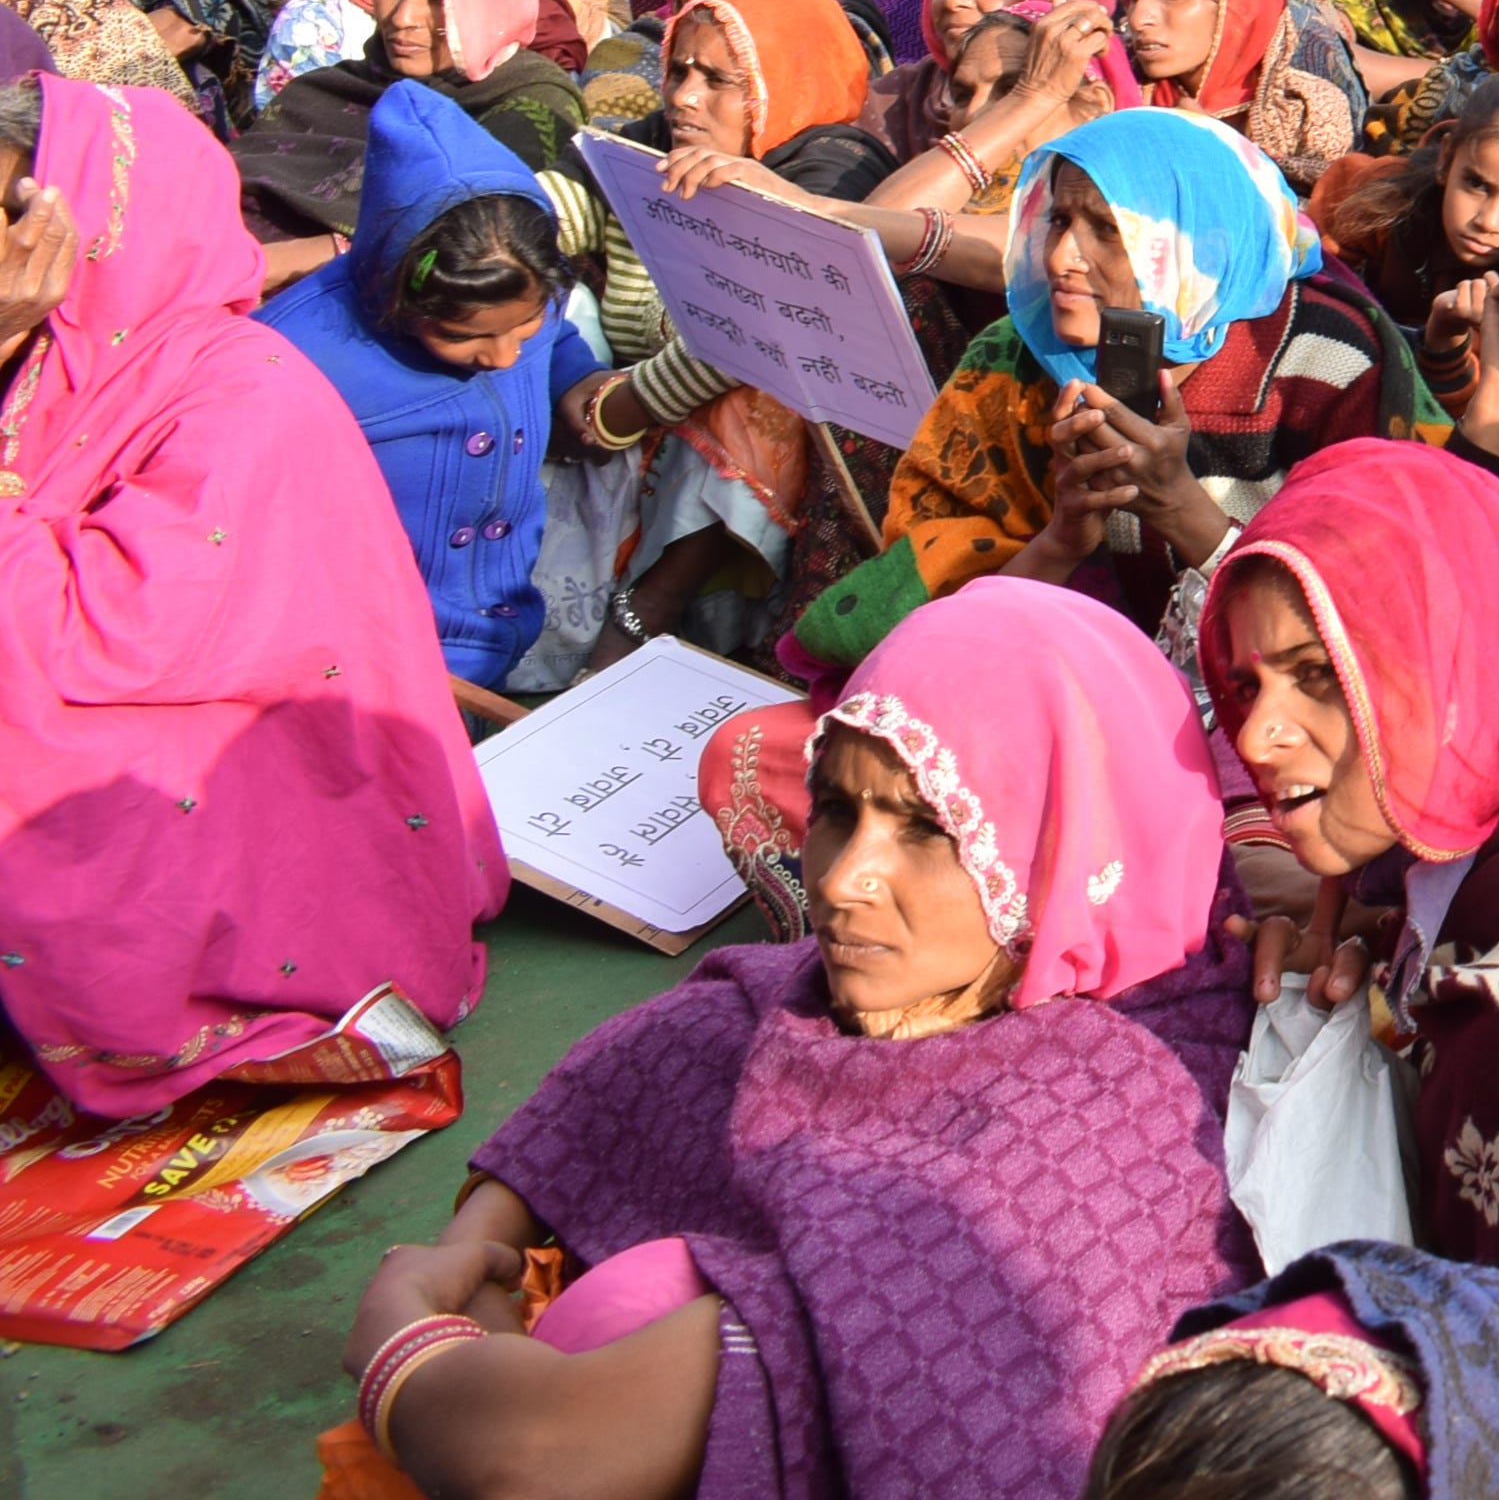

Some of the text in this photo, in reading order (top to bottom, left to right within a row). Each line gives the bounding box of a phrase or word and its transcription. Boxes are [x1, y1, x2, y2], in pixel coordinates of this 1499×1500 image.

[820, 264, 852, 295] की
[797, 355, 843, 385] नहीं
[674, 695, 747, 739] जवाब
[563, 765, 642, 813] जवाब
[527, 811, 571, 837] दो
[598, 794, 702, 868] सवाल है
[142, 1132, 218, 1197] SAVE
